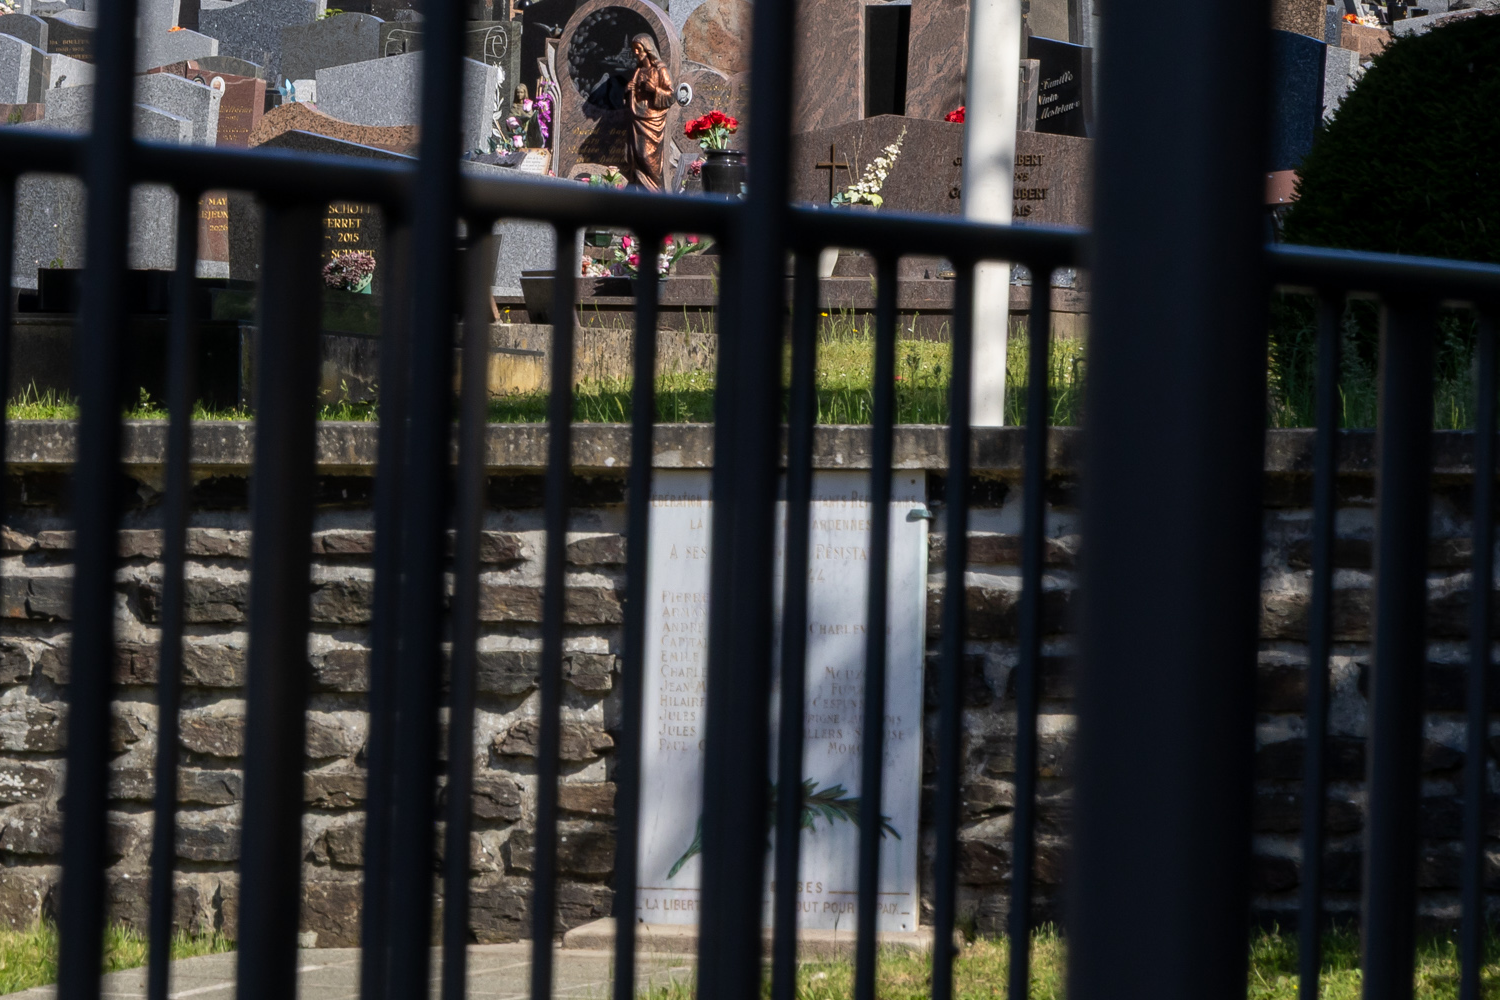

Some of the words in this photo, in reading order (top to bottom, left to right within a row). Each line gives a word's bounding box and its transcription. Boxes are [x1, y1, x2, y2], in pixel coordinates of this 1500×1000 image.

[338, 232, 360, 243] 2015
[660, 664, 708, 678] CHARLE
[663, 899, 700, 912] LIBERT
